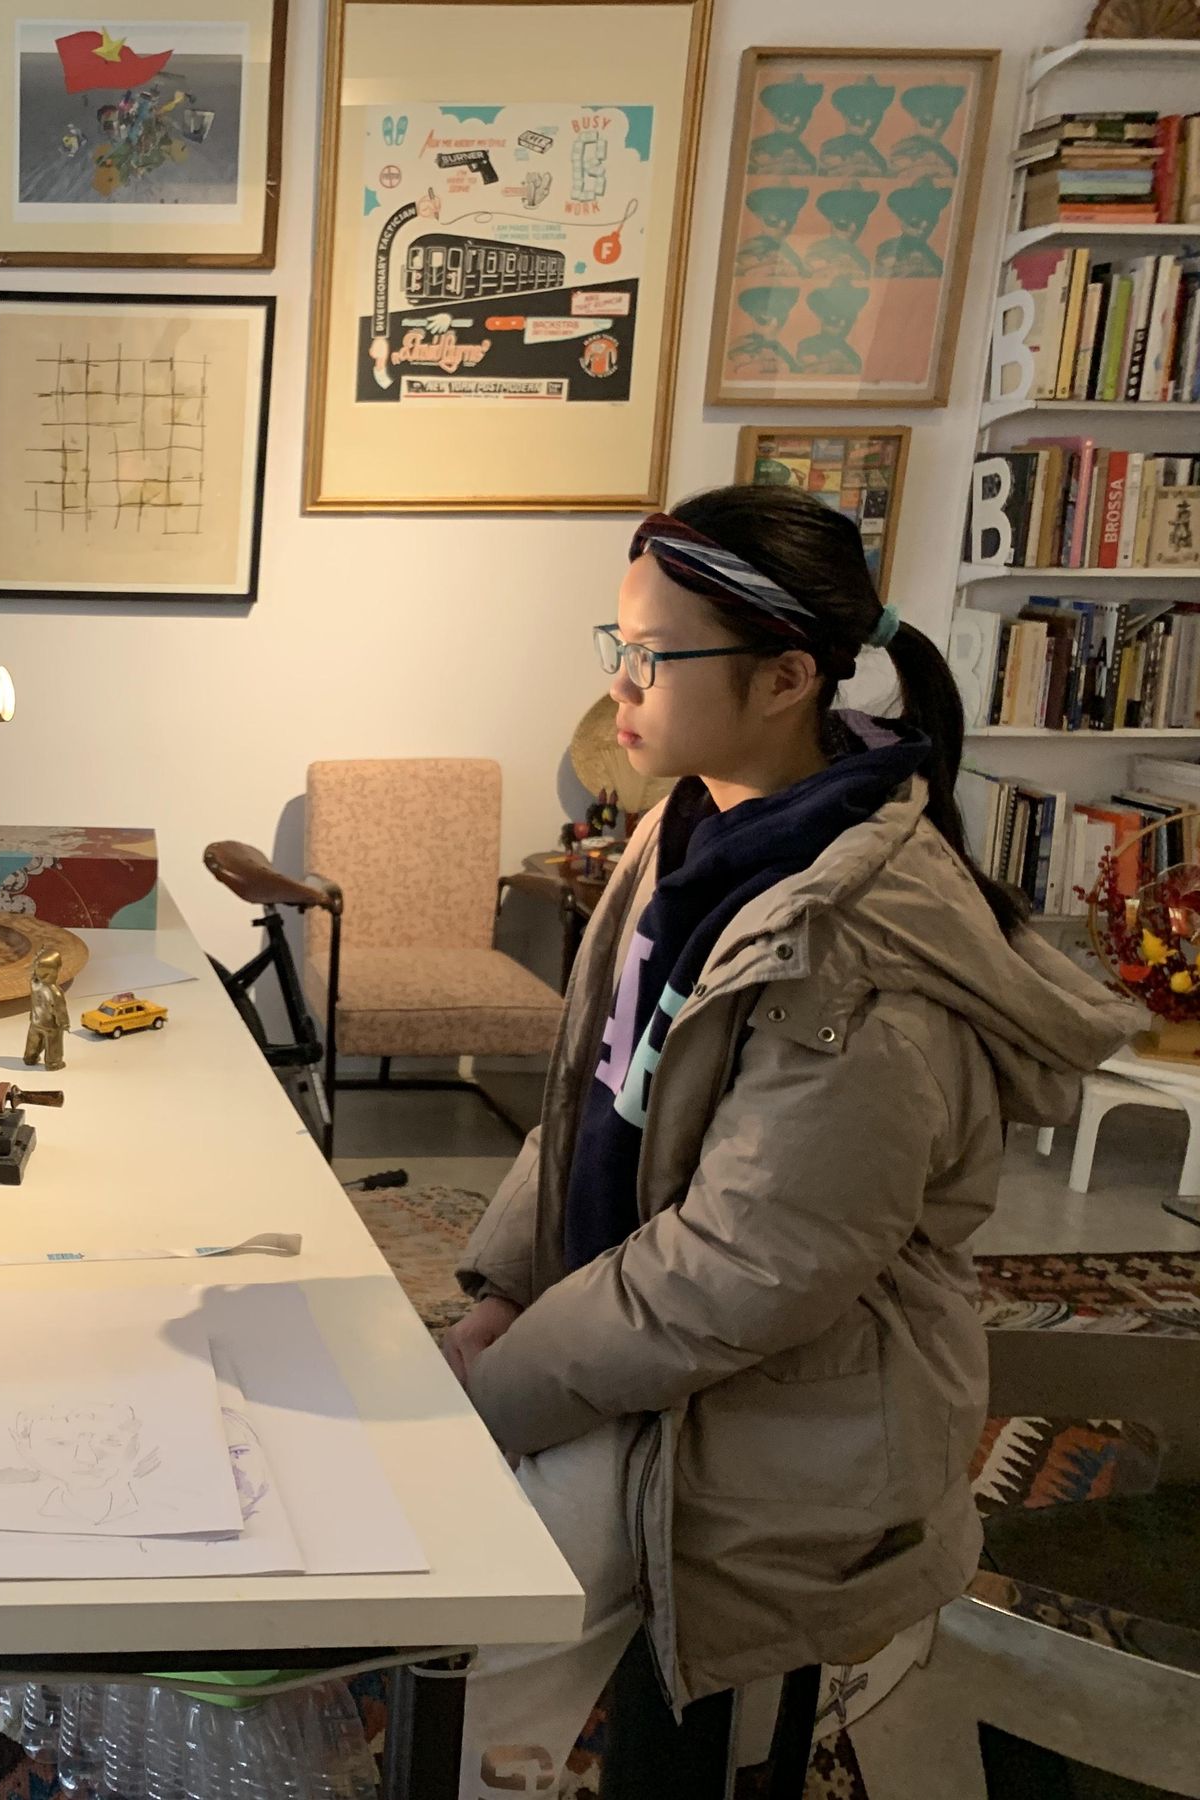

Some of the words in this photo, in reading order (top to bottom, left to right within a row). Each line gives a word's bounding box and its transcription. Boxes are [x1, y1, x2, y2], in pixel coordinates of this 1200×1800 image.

[571, 115, 612, 133] BUSY
[441, 151, 485, 163] BURNER
[378, 206, 416, 253] TACTICIAN
[564, 201, 600, 216] WORK
[601, 242, 613, 259] F
[375, 256, 387, 332] DIVERSIONARY
[990, 288, 1035, 401] B
[971, 456, 1013, 564] B
[1103, 478, 1124, 543] BROSSA
